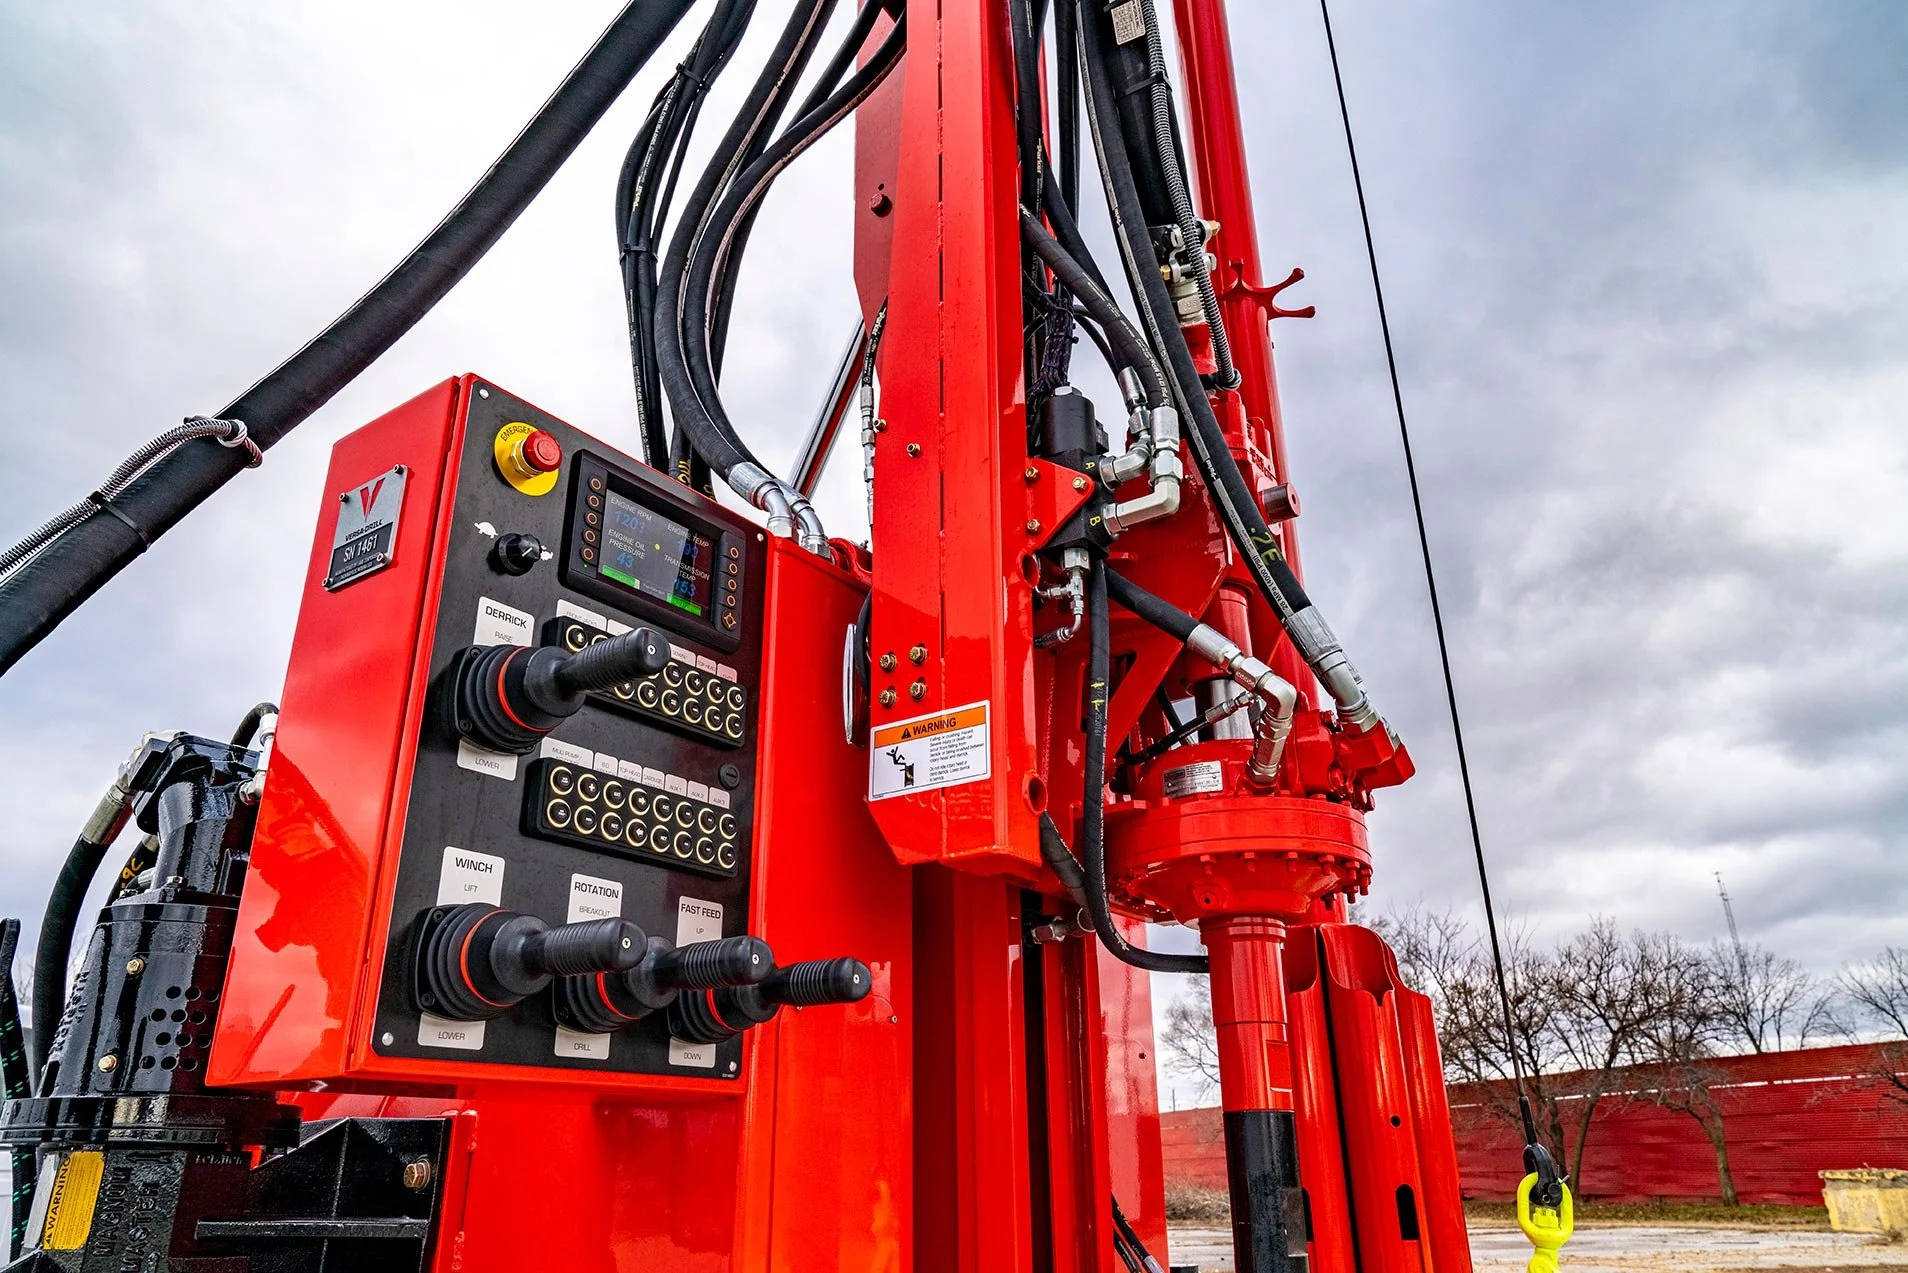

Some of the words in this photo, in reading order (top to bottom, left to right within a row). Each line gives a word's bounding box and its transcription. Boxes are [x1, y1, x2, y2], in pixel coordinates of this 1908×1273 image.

[872, 307, 886, 336] Parker
[610, 497, 637, 514] ENGINE
[636, 509, 652, 521] RPM
[1089, 516, 1101, 526] B
[345, 519, 383, 542] VERSA-DRILL
[667, 523, 692, 540] ENGINE
[692, 535, 710, 548] TEMP
[343, 543, 356, 562] SN
[357, 534, 378, 556] 1461
[608, 528, 634, 546] ENGINE
[634, 541, 646, 552] OIL
[608, 538, 646, 560] PRESSURE
[617, 552, 634, 568] 43
[664, 555, 710, 581] TRANSMISSION
[678, 570, 697, 581] TEMP
[1260, 568, 1273, 587] (4000
[1272, 586, 1282, 602] MPa
[1280, 602, 1288, 611] 28
[485, 605, 527, 629] DERRICK
[494, 631, 513, 643] RAISE
[912, 717, 957, 735] WARNING
[475, 757, 500, 770] LOWER
[455, 857, 493, 874] WINCH
[463, 884, 478, 893] LIFT
[574, 881, 619, 899] ROTATION
[579, 905, 611, 917] BREAKOUT
[680, 903, 701, 915] FAST
[701, 907, 721, 920] FEED
[695, 927, 705, 935] UP
[438, 1031, 466, 1041] LOWER
[573, 1042, 591, 1052] DRILL
[683, 1052, 702, 1061] DOWN
[47, 1155, 72, 1231] WARNING
[93, 1167, 133, 1257] MAGNUM
[120, 1182, 160, 1273] MASTER
